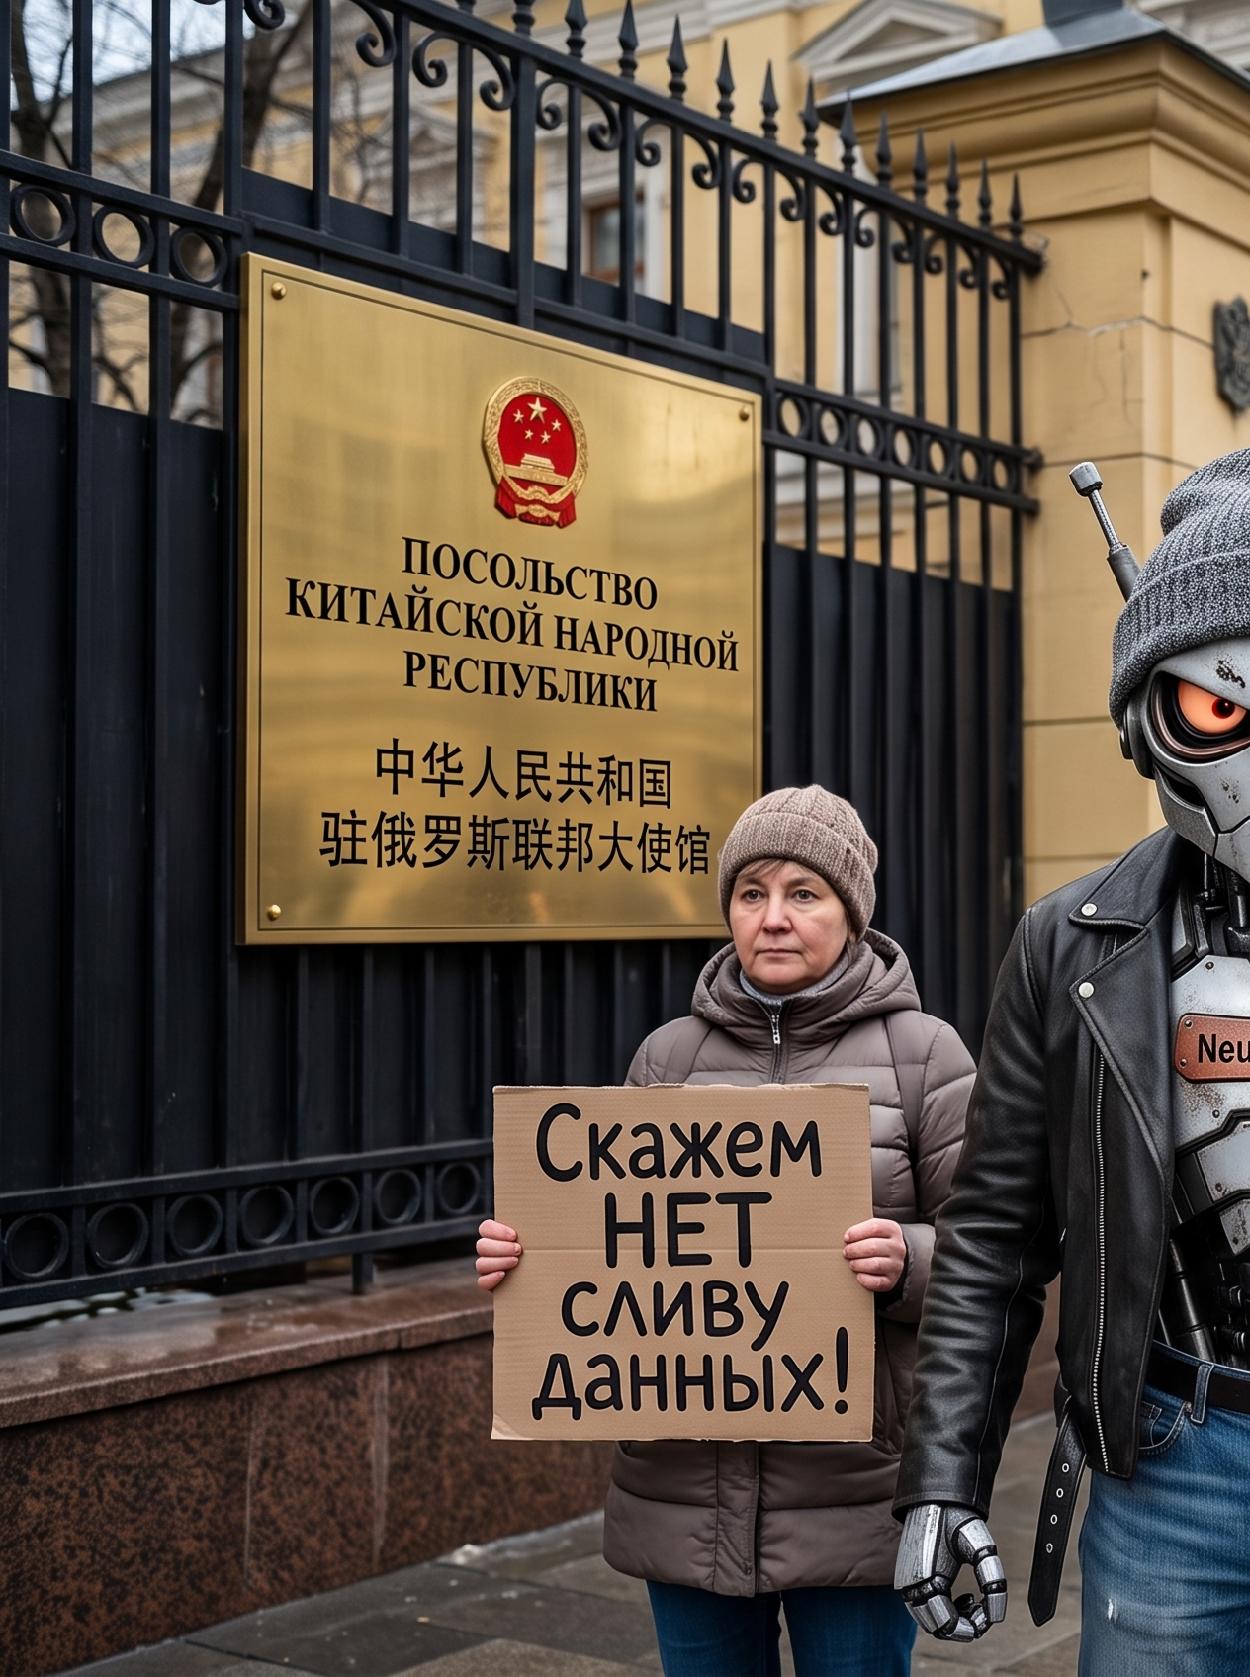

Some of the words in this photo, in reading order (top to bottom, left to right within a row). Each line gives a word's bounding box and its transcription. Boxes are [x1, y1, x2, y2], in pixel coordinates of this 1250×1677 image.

[401, 537, 659, 611] ПОСОЛЬСТВО
[286, 577, 544, 648] КИТАЙСКОЙ
[554, 614, 739, 672] НАРОДНОЙ
[402, 651, 658, 712] РЕСПУБЛИКИ
[375, 737, 672, 810] 中华人民共和国
[318, 809, 711, 875] 驻俄罗斯联邦大使馆
[536, 1102, 822, 1182] Скажем
[604, 1191, 772, 1269] НЕТ
[561, 1280, 790, 1352] сливу
[532, 1327, 849, 1421] данных!
